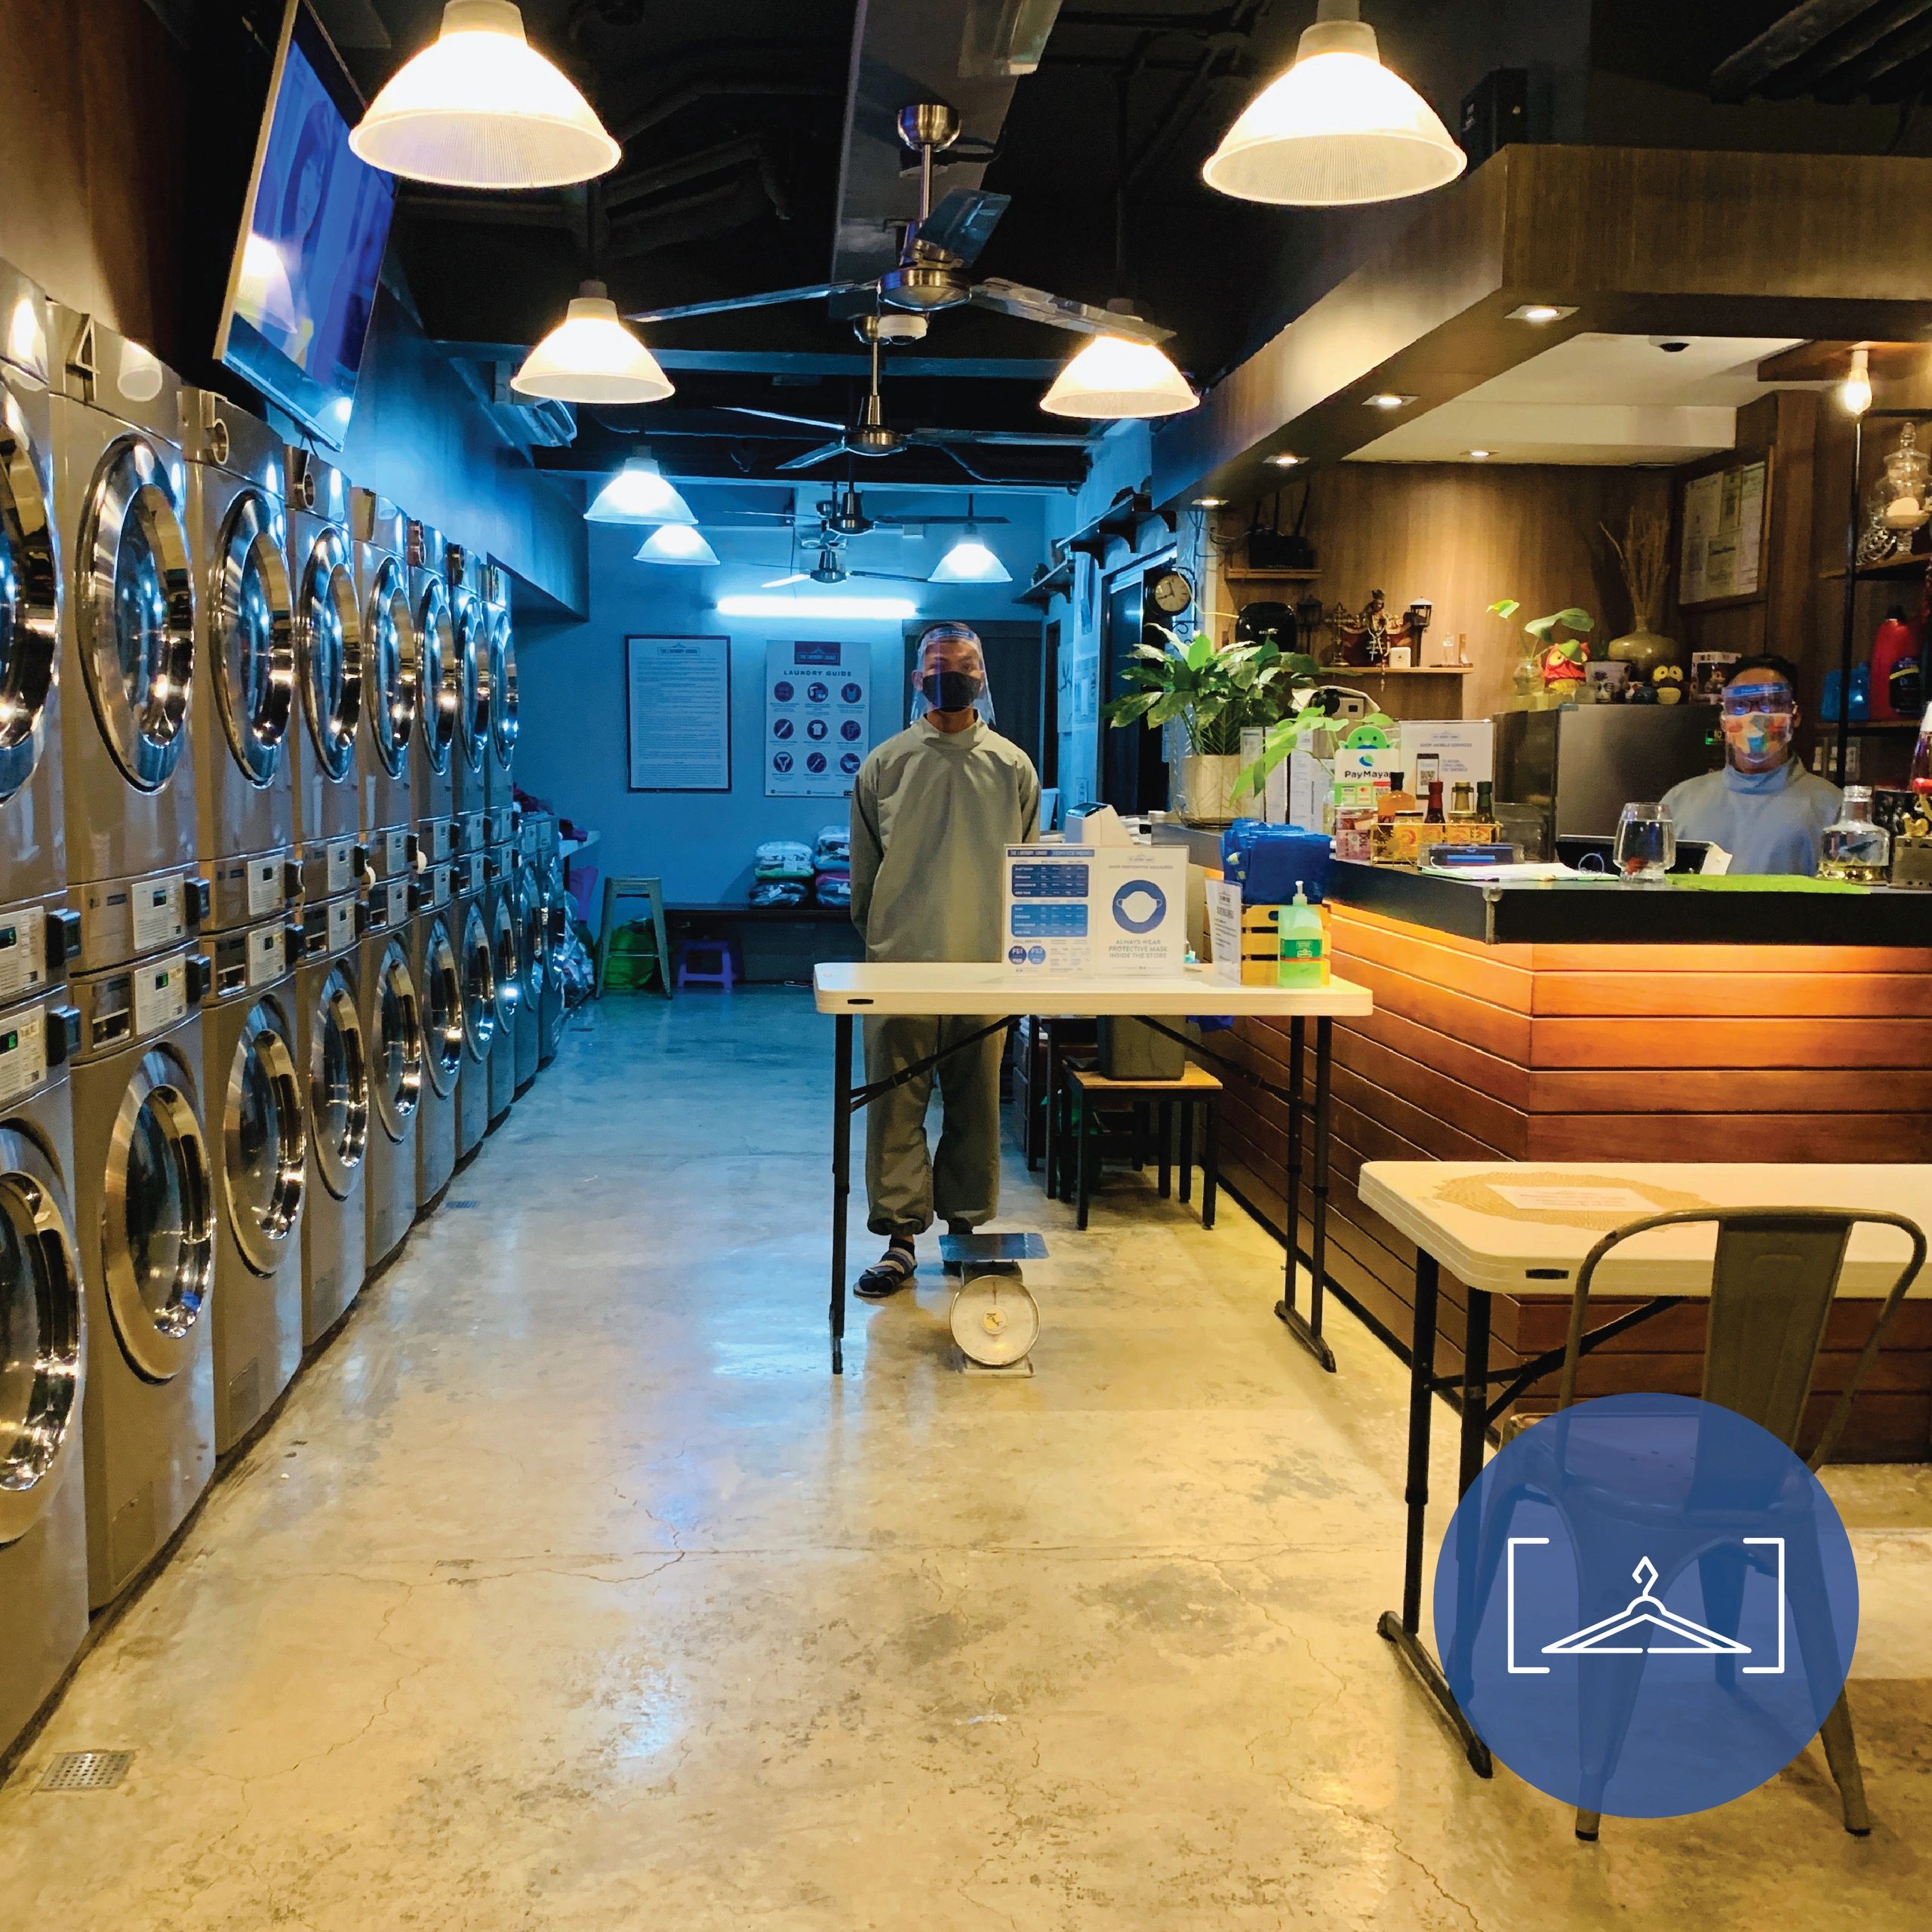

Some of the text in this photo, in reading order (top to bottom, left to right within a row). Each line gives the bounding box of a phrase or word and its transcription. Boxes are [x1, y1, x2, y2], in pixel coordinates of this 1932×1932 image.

[66, 313, 100, 403] 4
[206, 390, 229, 466] 5
[297, 451, 315, 509] 6
[1344, 771, 1389, 779] PayMaya
